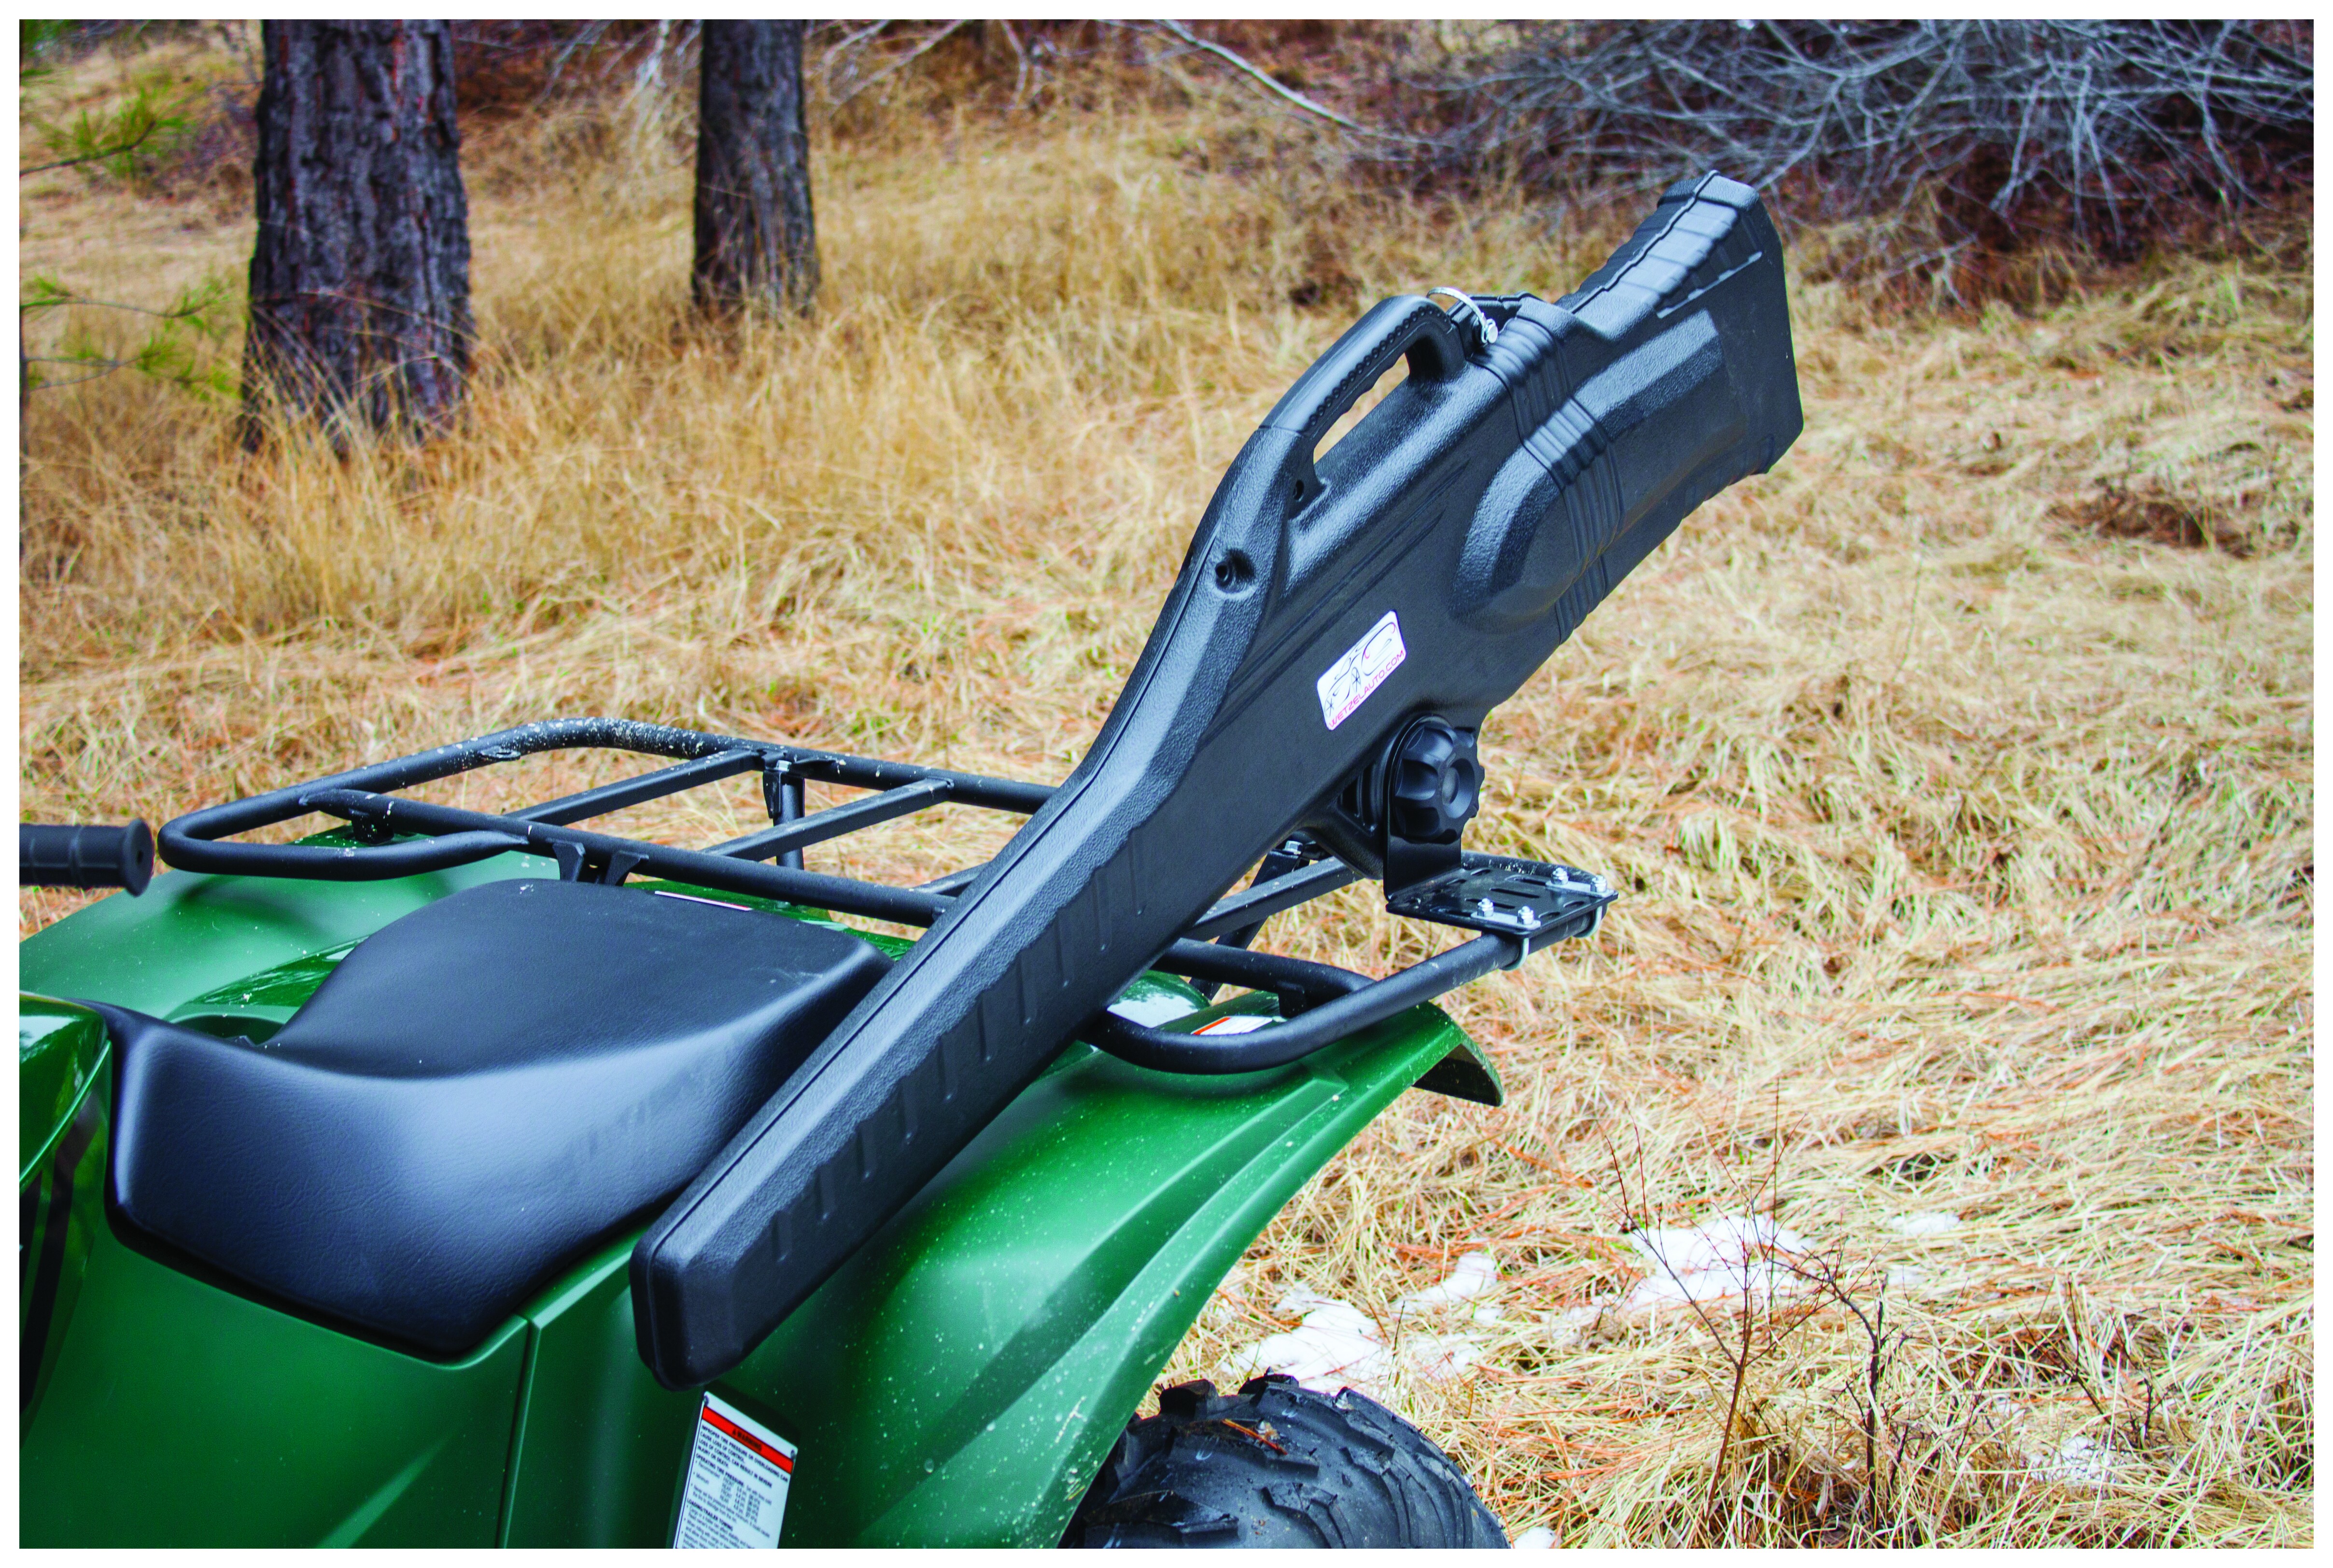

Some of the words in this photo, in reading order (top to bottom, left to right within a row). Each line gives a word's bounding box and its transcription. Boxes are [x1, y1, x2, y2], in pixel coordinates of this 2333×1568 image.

[1329, 650, 1404, 728] WETZELAUTO.COM
[700, 1431, 711, 1441] CAUSE
[713, 1439, 721, 1448] LOSS
[698, 1445, 710, 1456] INJURY
[702, 1424, 719, 1439] IMPROPER
[729, 1442, 747, 1456] PRESSURE
[755, 1458, 779, 1477] OVERLOADING
[696, 1453, 715, 1469] OPERATING
[699, 1438, 708, 1447] LOSS
[715, 1448, 730, 1461] CONTROL
[740, 1464, 753, 1475] RESULT
[759, 1476, 772, 1487] SEVERE
[719, 1518, 733, 1530] TOWING
